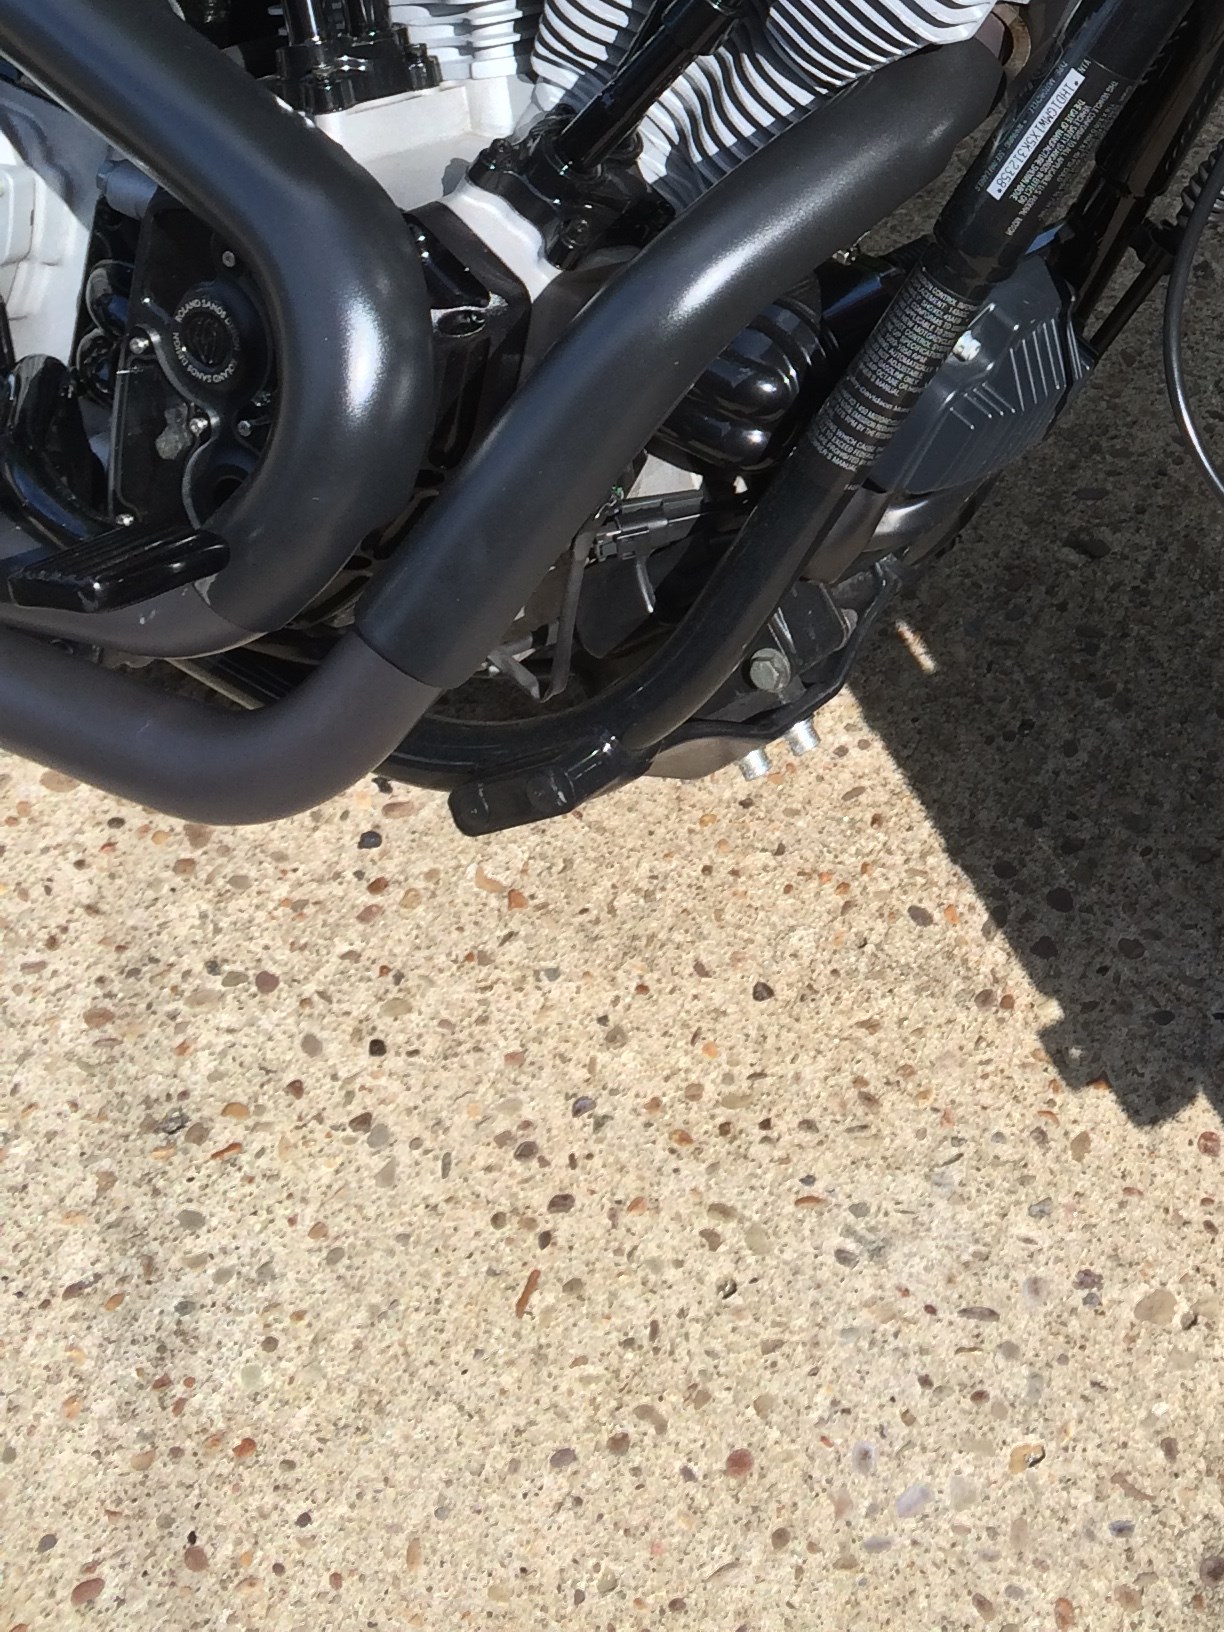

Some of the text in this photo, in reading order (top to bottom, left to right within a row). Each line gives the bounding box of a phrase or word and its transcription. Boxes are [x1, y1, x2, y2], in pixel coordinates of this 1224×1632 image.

[1076, 57, 1092, 74] VIN
[1090, 90, 1111, 114] VEHICLE
[1071, 110, 1097, 142] CONFORMS
[874, 367, 900, 387] OCTANE
[830, 435, 855, 454] EXCEED
[834, 427, 858, 446] WHICH
